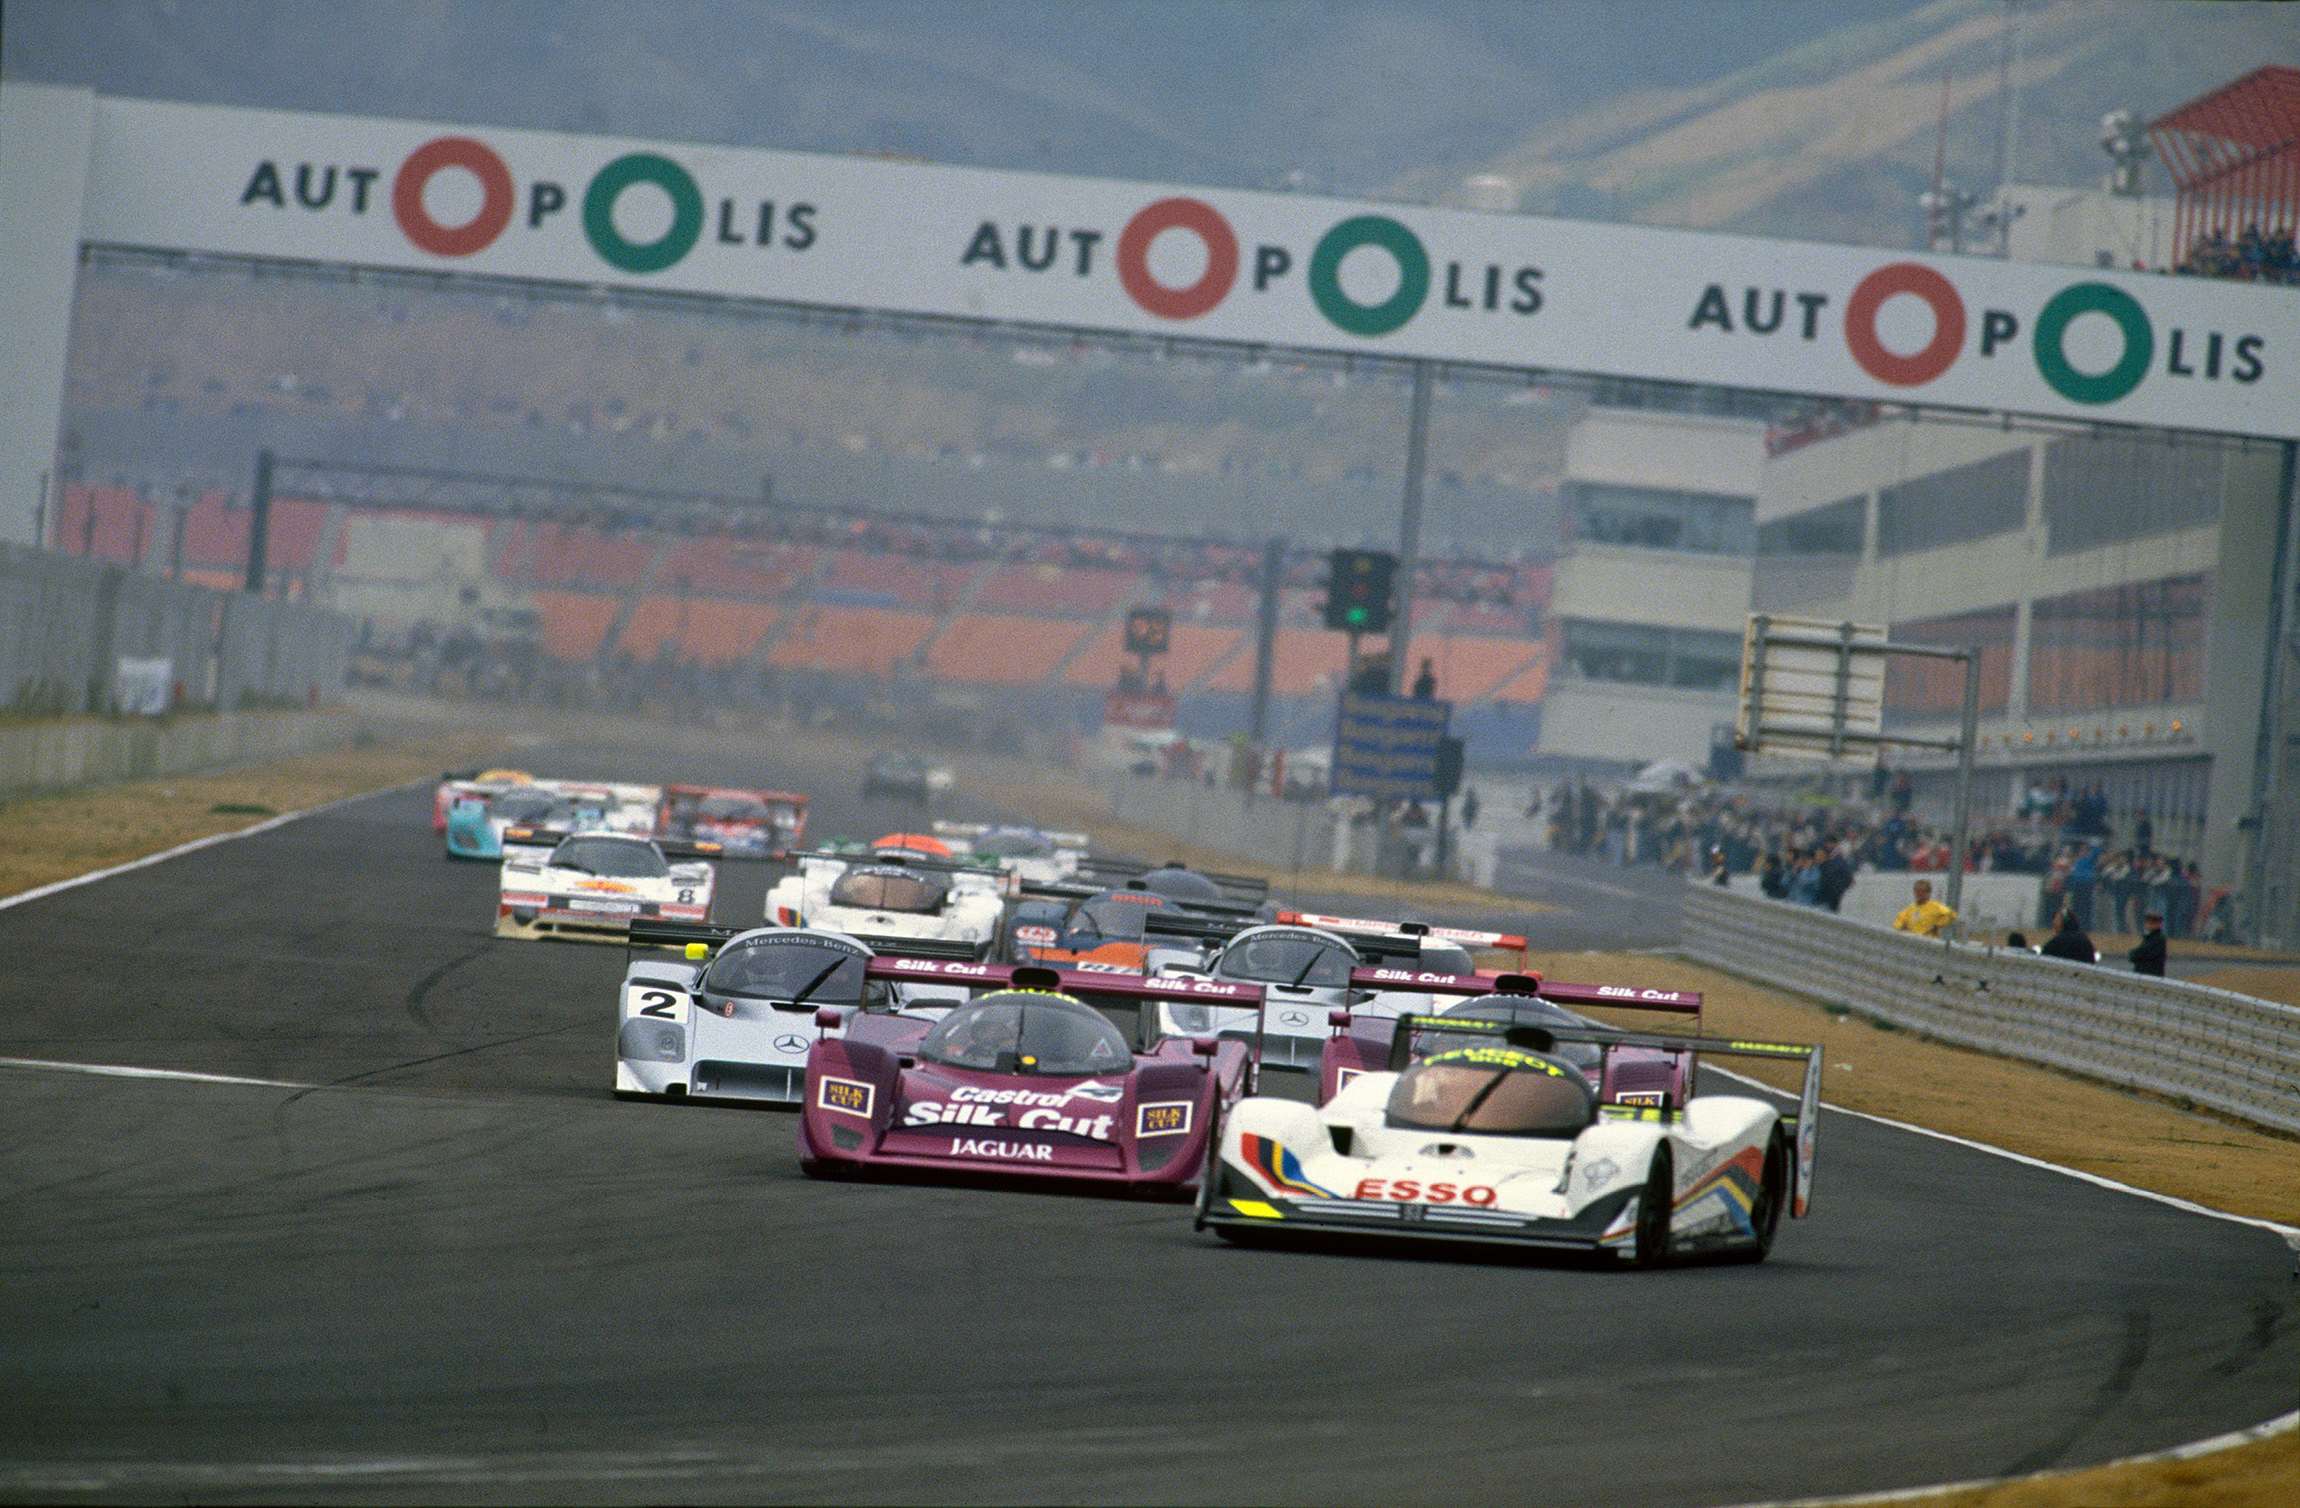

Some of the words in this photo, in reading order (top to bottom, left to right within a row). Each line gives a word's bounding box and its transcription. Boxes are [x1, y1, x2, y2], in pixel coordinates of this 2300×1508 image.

[239, 134, 818, 273] AUTOPOLIS
[961, 197, 1545, 338] AUTOPOLIS
[1688, 262, 2267, 407] AUTOPOLIS
[893, 958, 939, 972] Silk
[943, 962, 988, 975] Cut
[1373, 968, 1414, 981] Silk
[1417, 972, 1457, 985] Cut
[1143, 978, 1188, 992] Silk
[1193, 982, 1238, 995] Cut
[1596, 985, 1637, 998] Silk
[1640, 989, 1681, 1001] Cut
[640, 991, 677, 1019] 2
[949, 1085, 1074, 1108] Castrol
[903, 1100, 1006, 1126] Silk
[1018, 1108, 1114, 1140] Cut
[949, 1137, 1054, 1161] JAGUAR
[1355, 1177, 1497, 1206] ESSO
